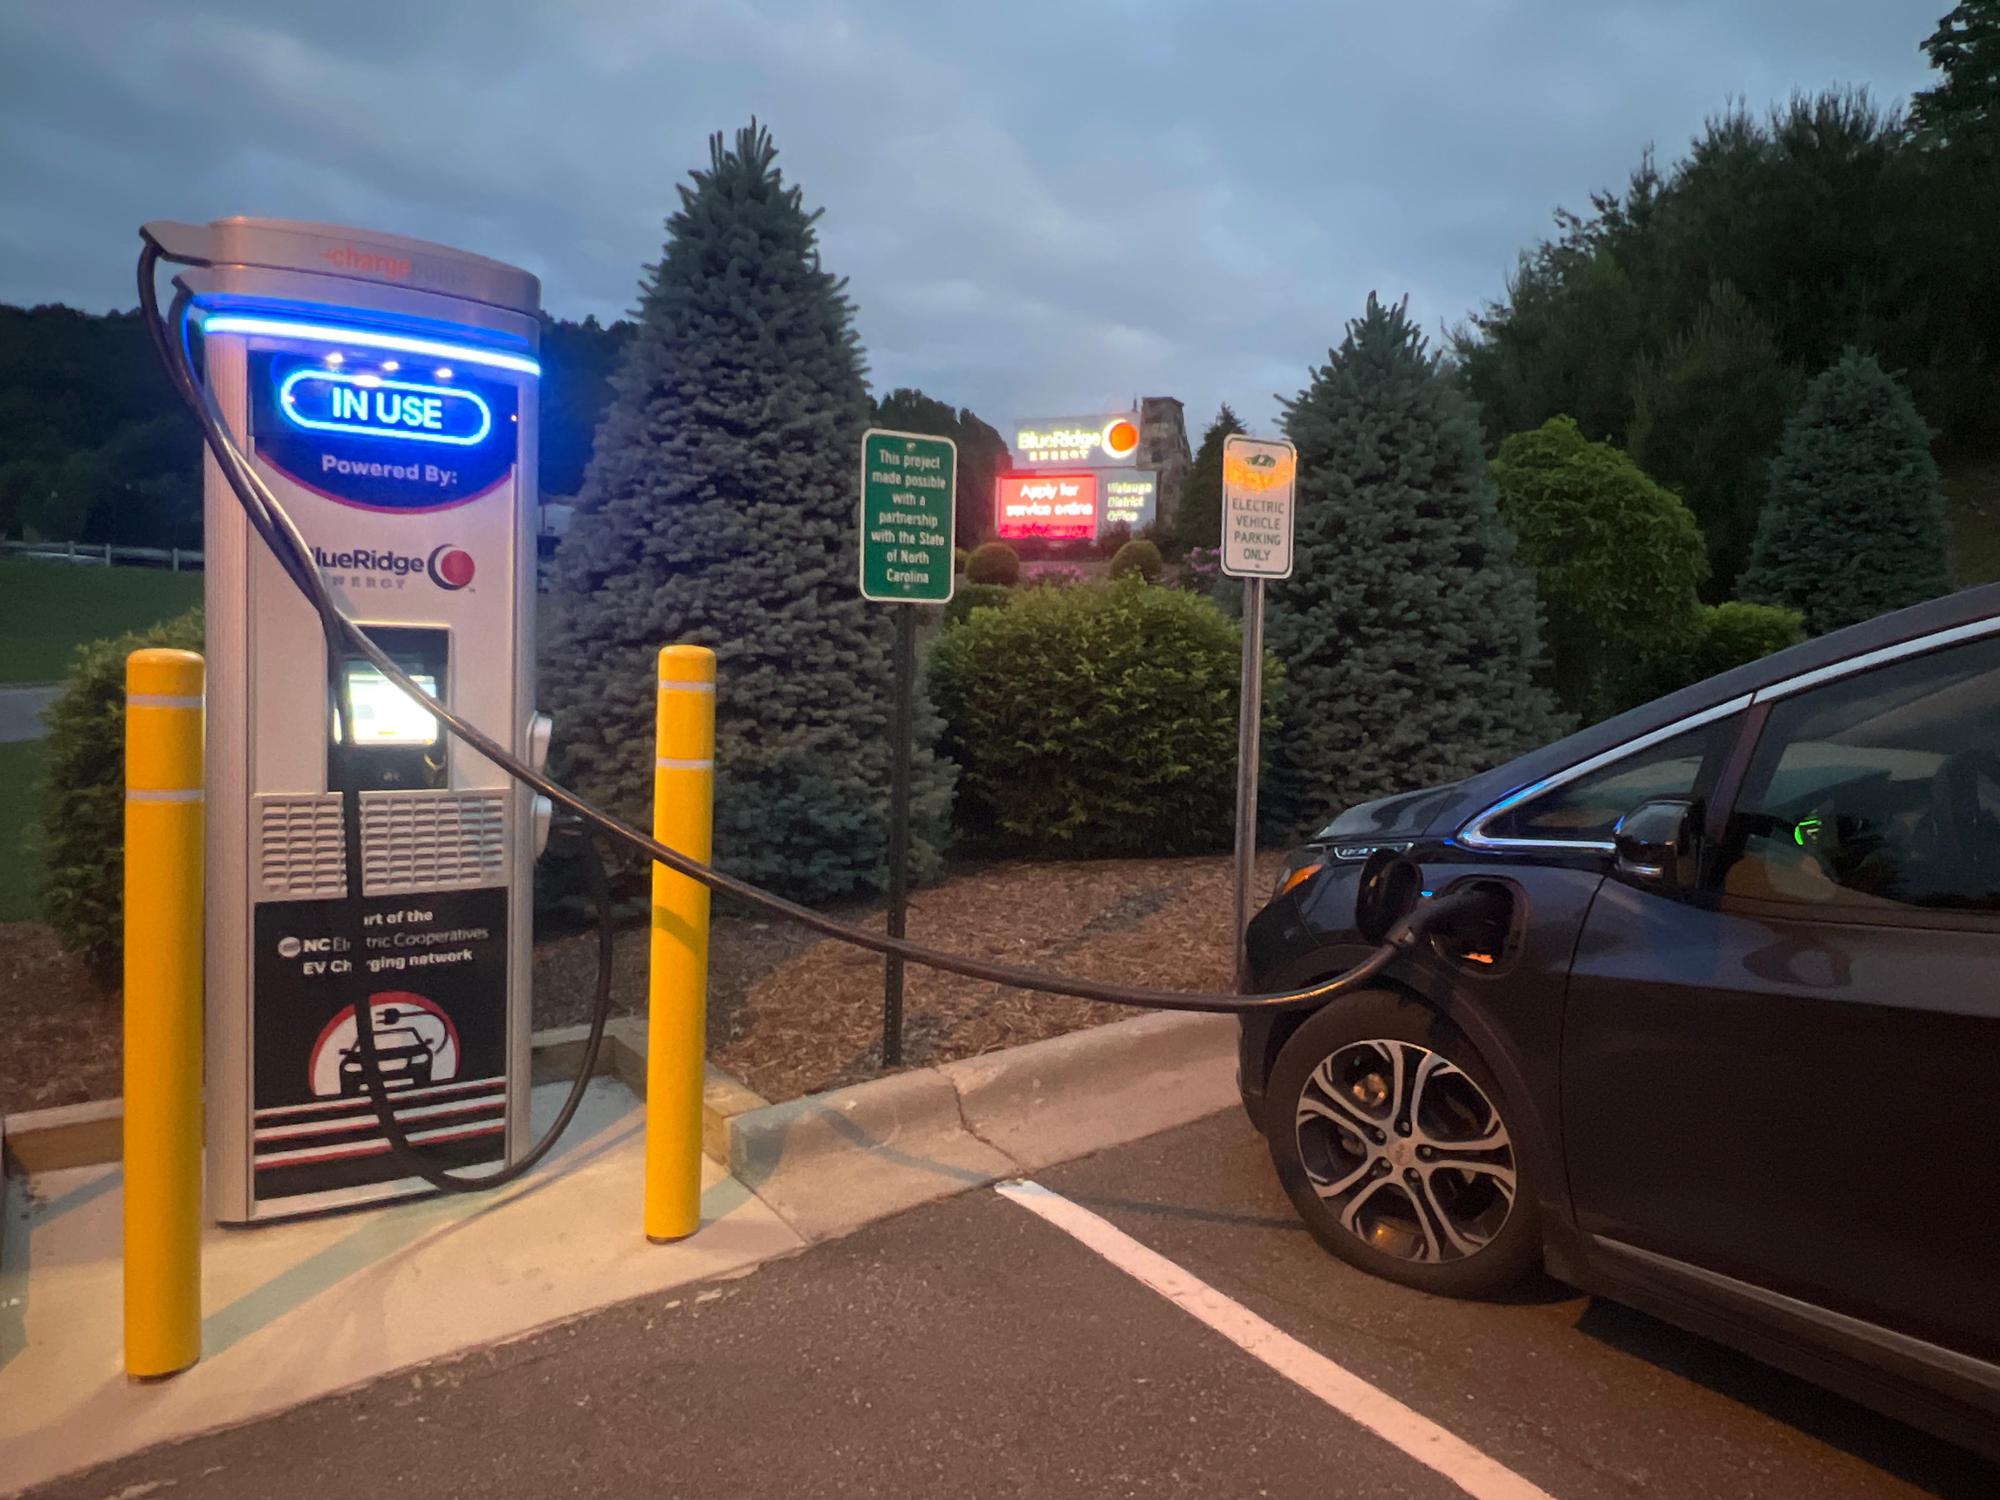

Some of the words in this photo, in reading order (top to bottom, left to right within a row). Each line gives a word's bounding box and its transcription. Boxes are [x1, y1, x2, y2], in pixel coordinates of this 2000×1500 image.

[332, 387, 368, 420] IN
[376, 391, 442, 429] USE
[1018, 430, 1102, 449] BlueRidge
[880, 450, 899, 465] This
[903, 454, 940, 472] project
[1029, 449, 1089, 461] ENERGY
[322, 454, 419, 479] Powered
[425, 464, 457, 486] By:
[872, 471, 901, 484] made
[905, 473, 946, 490] possible
[1020, 485, 1057, 499] Apply
[1060, 483, 1079, 495] for
[892, 494, 916, 505] with
[919, 496, 926, 506] a
[1107, 496, 1144, 507] District
[1232, 498, 1285, 514] ELECTRIC
[879, 511, 938, 529] partnership
[1107, 510, 1138, 521] Office
[1236, 515, 1281, 531] VEHICLE
[871, 531, 895, 543] with
[899, 533, 916, 545] the
[919, 532, 945, 546] State
[1234, 531, 1281, 546] PARKING
[310, 547, 424, 576] lueRidge
[886, 551, 897, 563] of
[901, 551, 930, 565] North
[1243, 550, 1271, 561] ONLY
[325, 574, 406, 590] NERGY
[886, 568, 929, 584] Carolina
[386, 911, 404, 925] of
[407, 909, 433, 923] the
[303, 938, 330, 953] NC
[393, 928, 489, 948] Cooperatives
[303, 961, 326, 975] EV
[409, 949, 473, 966] network
